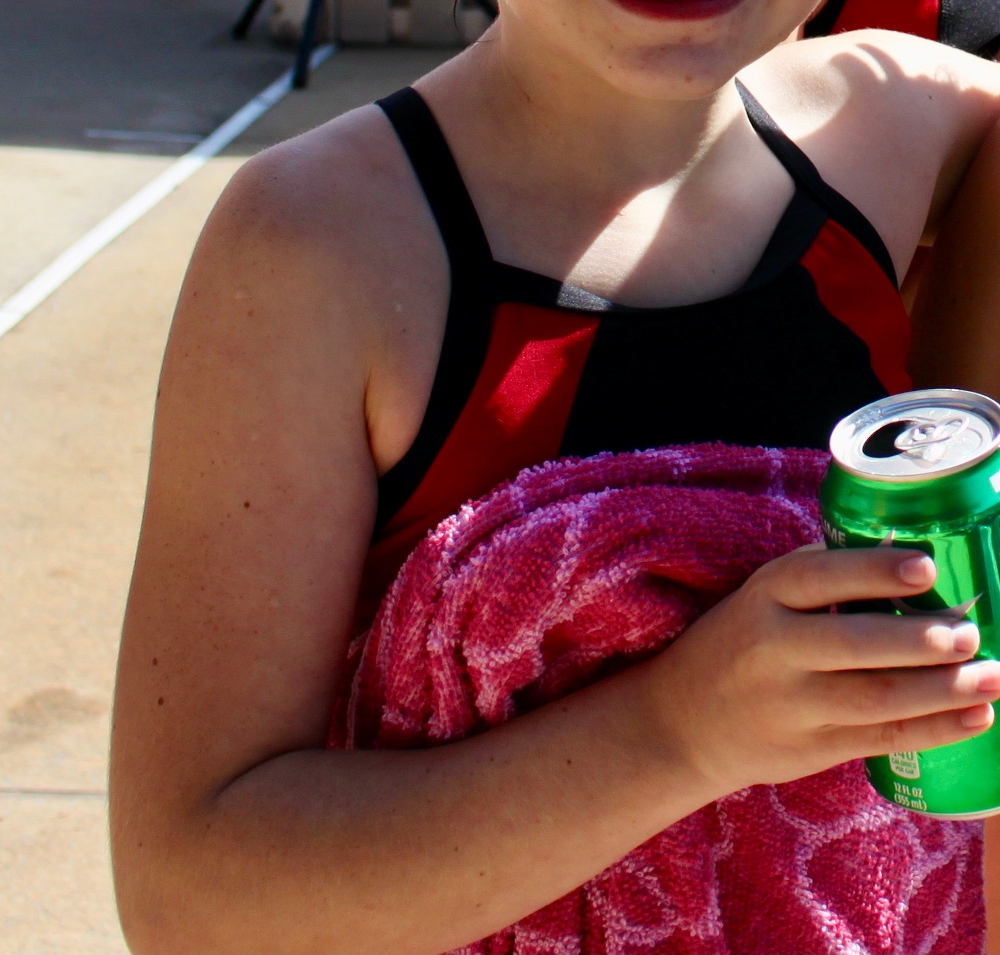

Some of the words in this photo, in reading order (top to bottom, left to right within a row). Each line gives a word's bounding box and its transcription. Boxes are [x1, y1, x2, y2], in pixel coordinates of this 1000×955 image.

[894, 781, 901, 793] 12
[902, 785, 910, 796] FL
[911, 787, 923, 798] OZ
[894, 793, 910, 807] (355
